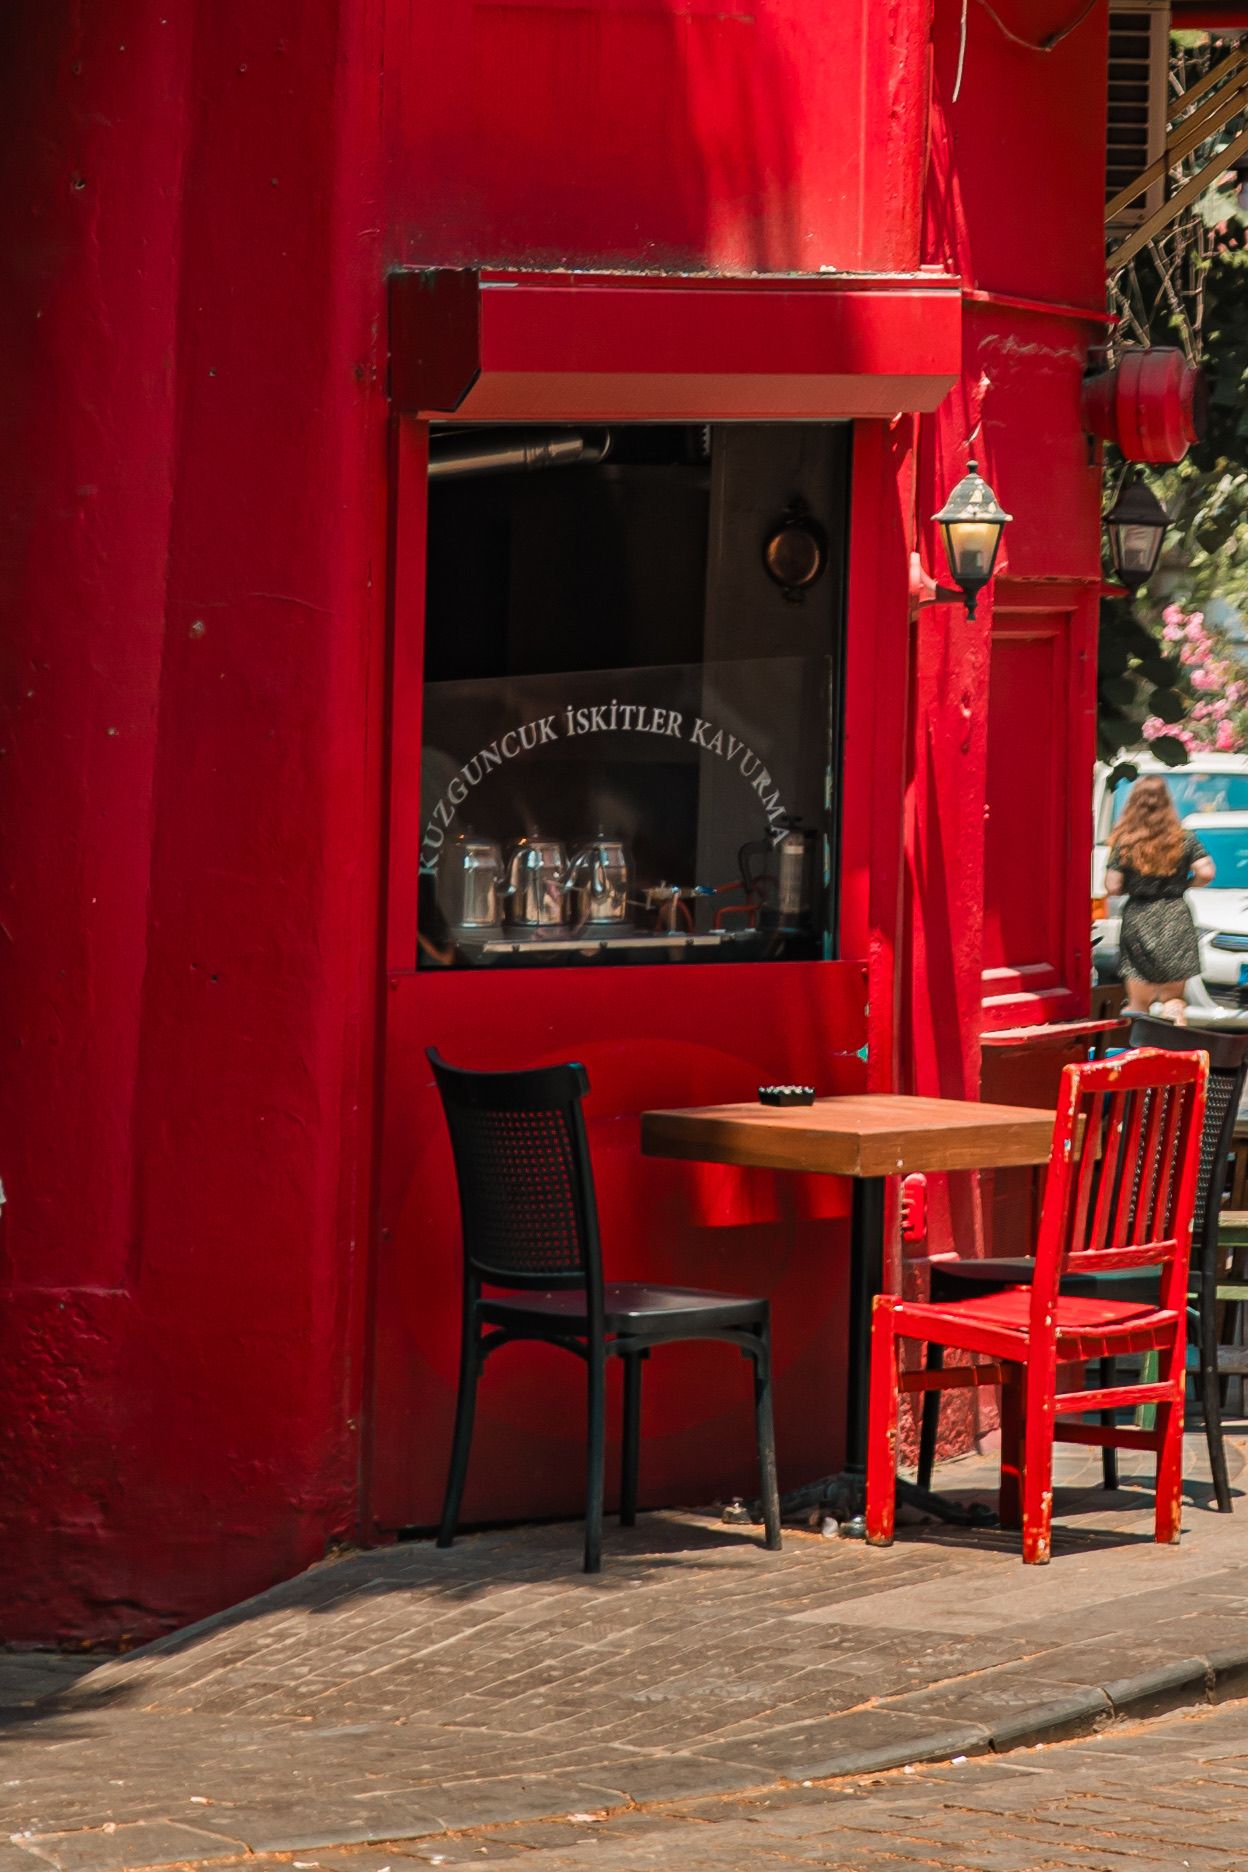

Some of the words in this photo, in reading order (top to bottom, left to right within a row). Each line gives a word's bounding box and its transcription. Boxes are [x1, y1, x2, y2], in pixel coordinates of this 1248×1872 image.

[418, 716, 558, 877] KUZGUNCUK
[566, 698, 683, 739] İSKİTLER
[689, 718, 791, 847] KAVURMA
